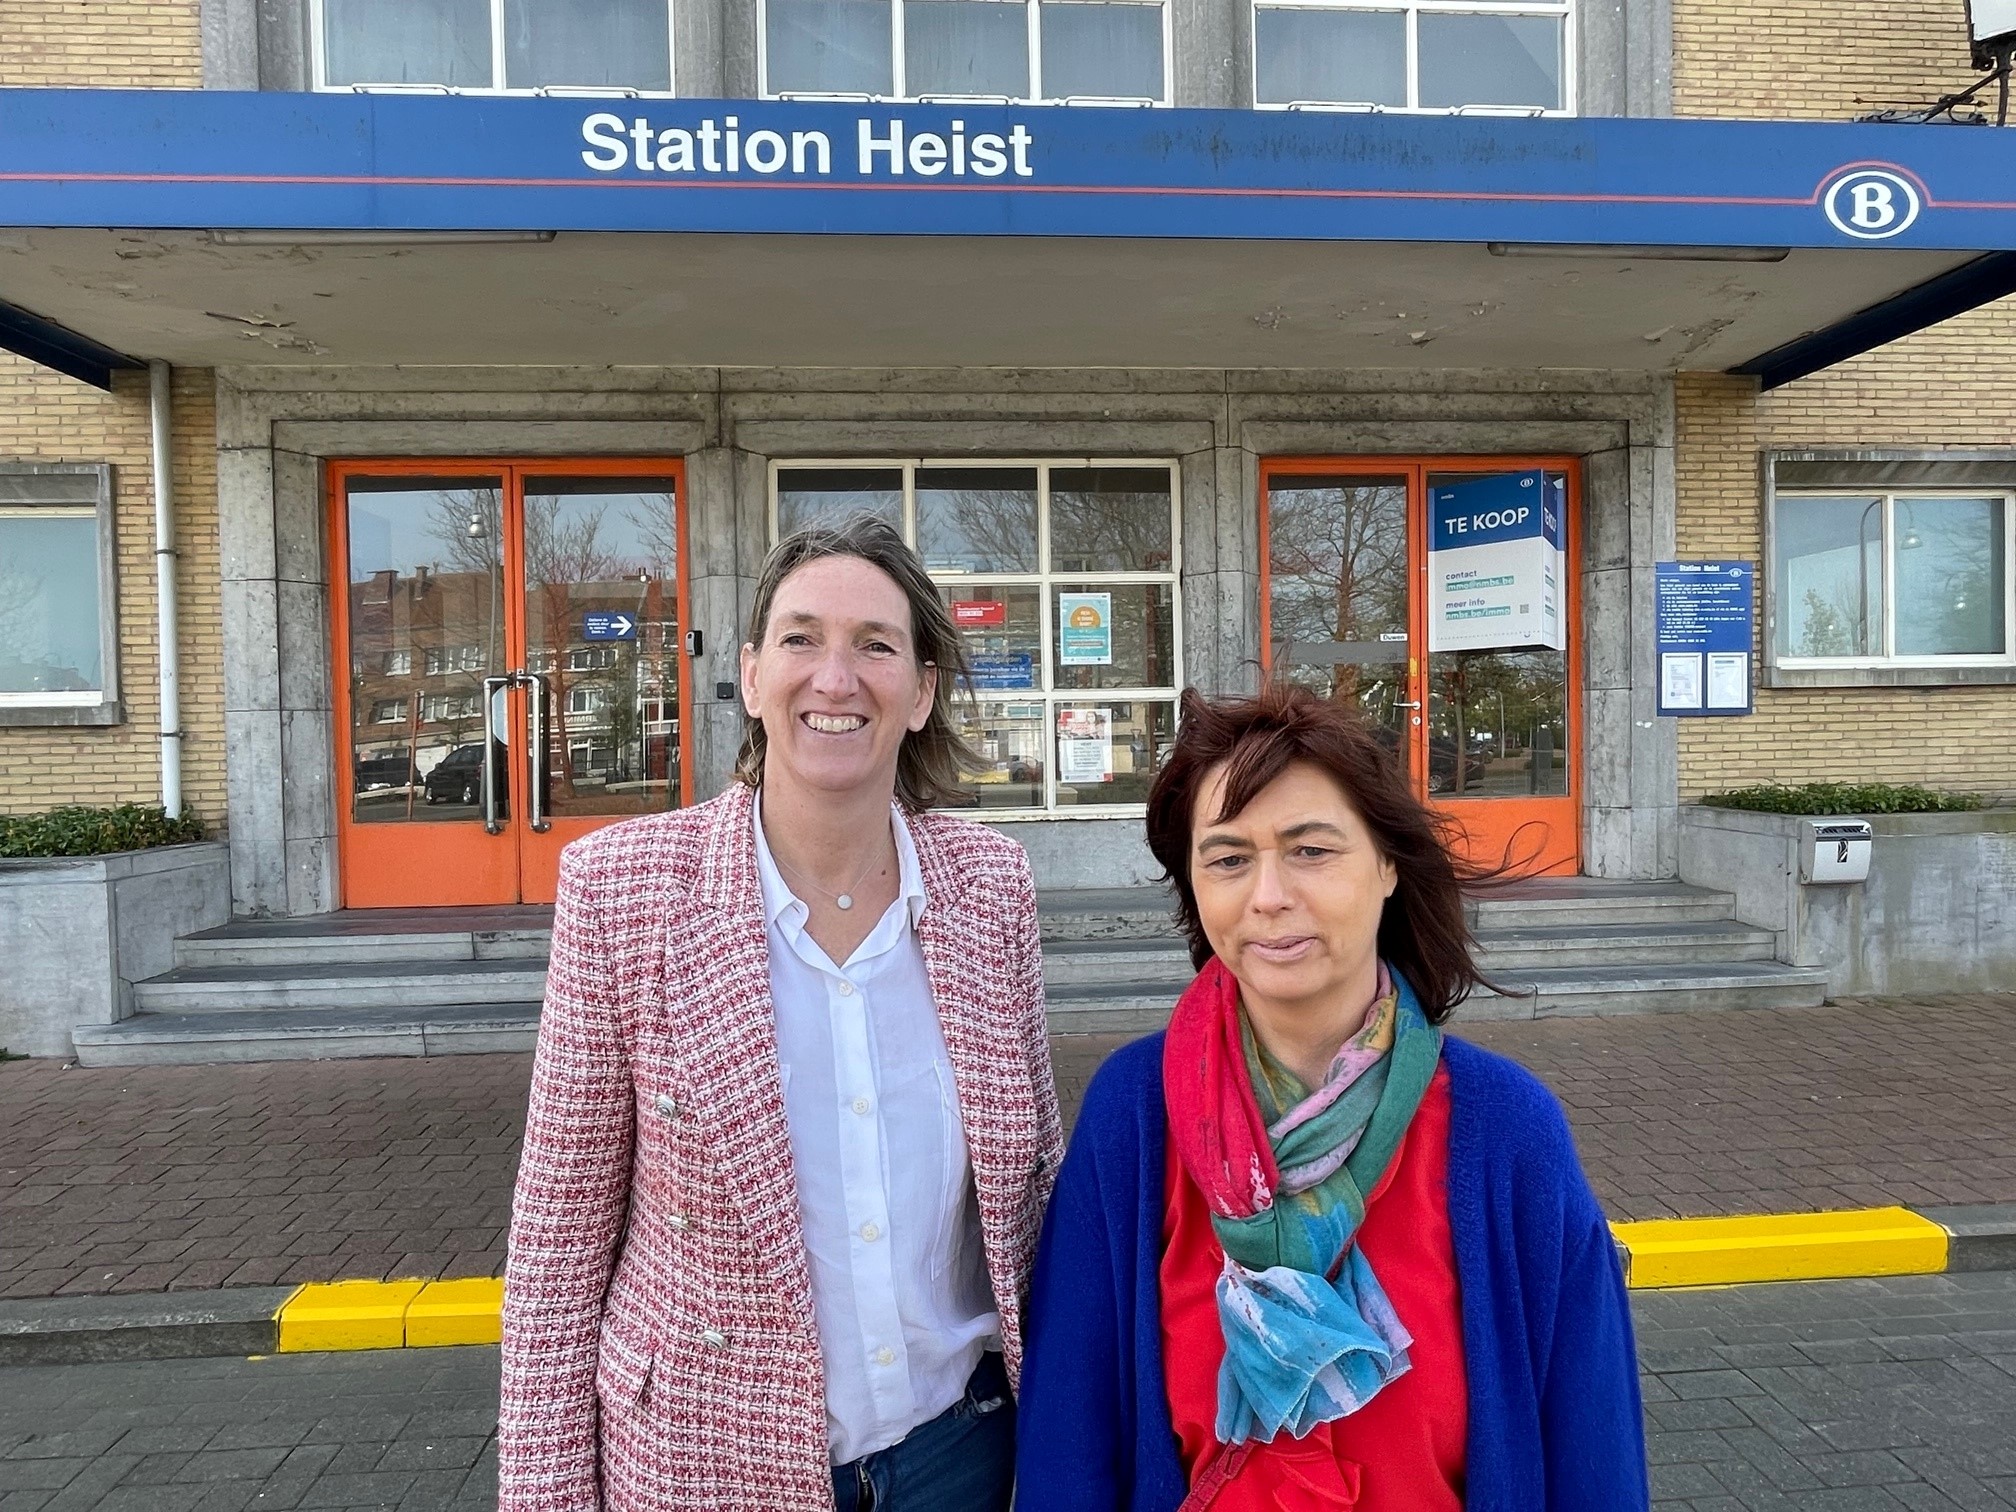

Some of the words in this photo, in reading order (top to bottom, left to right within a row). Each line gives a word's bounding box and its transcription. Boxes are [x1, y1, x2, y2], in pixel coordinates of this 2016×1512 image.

[581, 112, 831, 174] Station
[858, 118, 1033, 177] Heist
[1445, 516, 1468, 535] TE
[1473, 506, 1530, 531] KOOP
[1445, 570, 1477, 580] contact
[1446, 601, 1467, 609] meer
[1468, 598, 1486, 607] info
[1446, 607, 1511, 620] nmbs.be/immo
